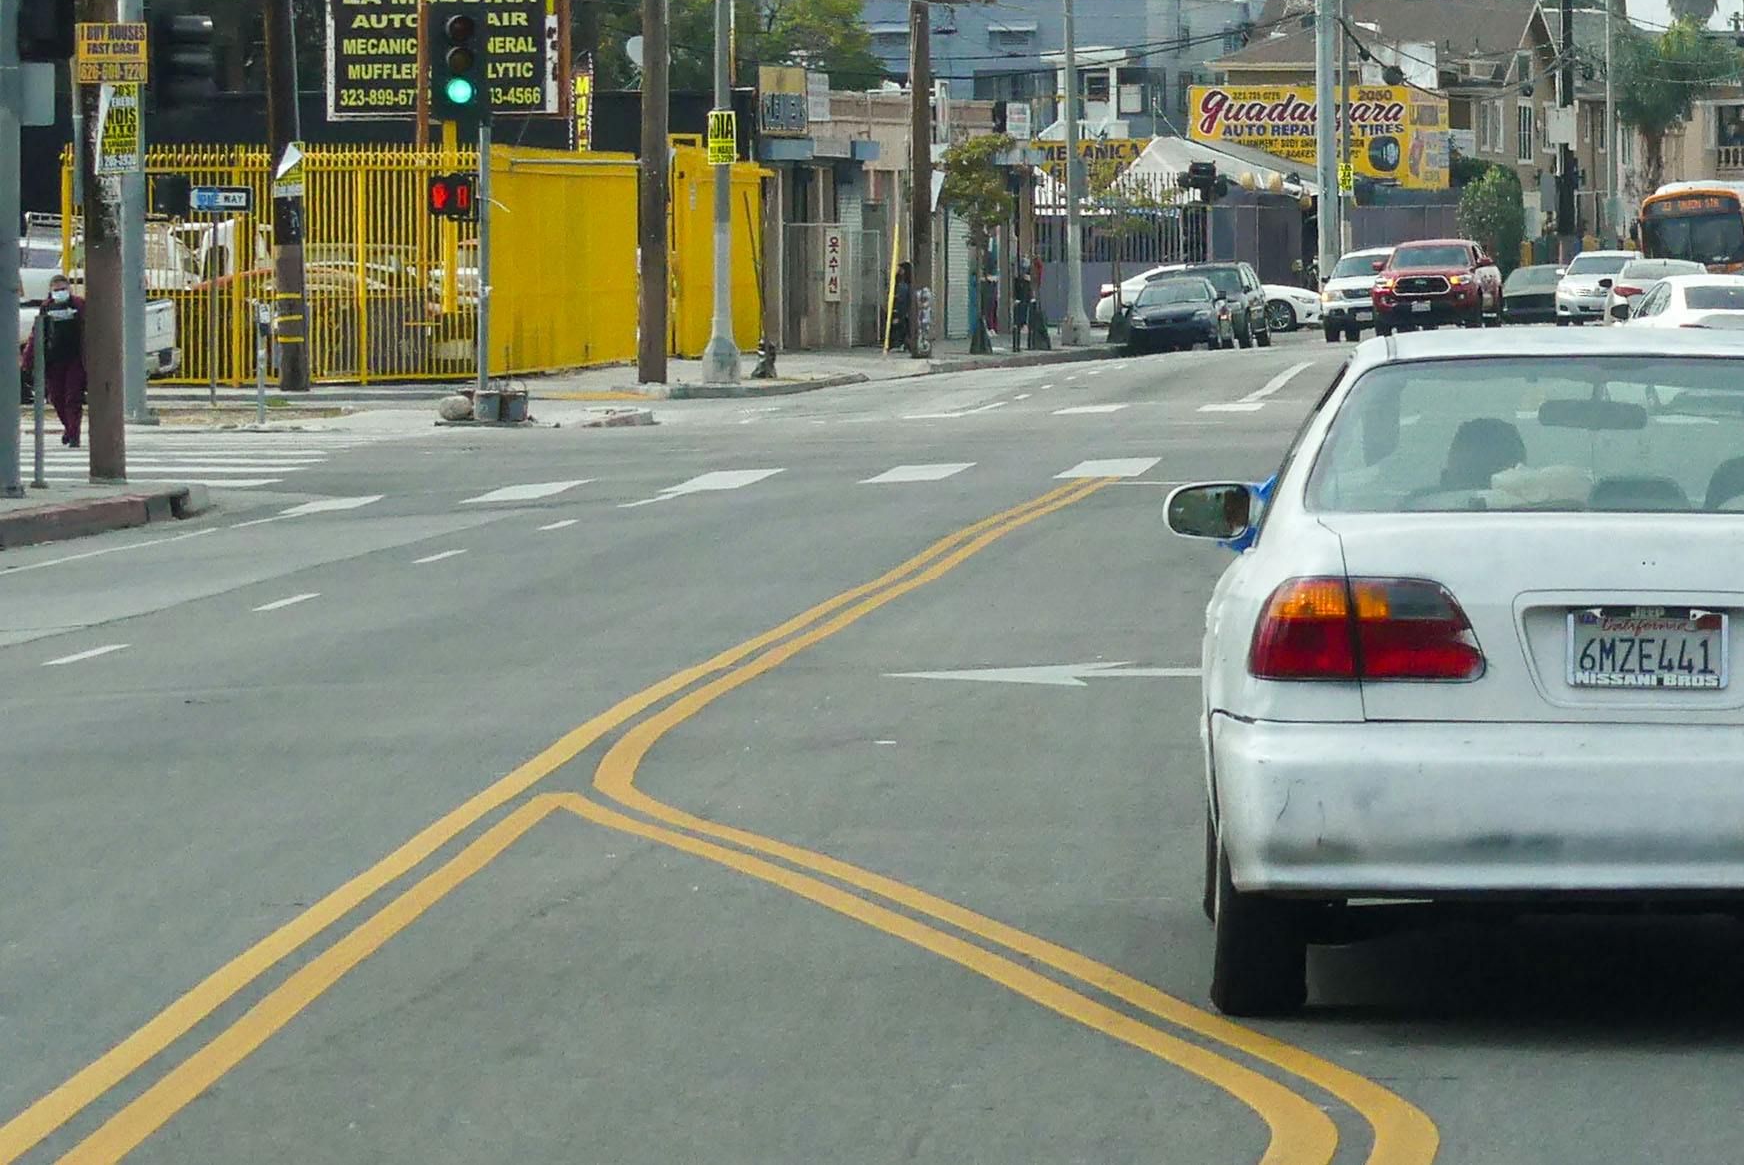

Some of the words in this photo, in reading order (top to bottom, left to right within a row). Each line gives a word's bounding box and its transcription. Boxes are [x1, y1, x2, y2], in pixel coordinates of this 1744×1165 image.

[87, 43, 110, 55] FAST
[112, 43, 140, 55] CASH
[1222, 123, 1267, 137] AUTO
[1271, 123, 1316, 137] REPAI
[1360, 122, 1405, 137] TIRES
[1036, 142, 1142, 162] MEANICA
[222, 194, 244, 205] WAY
[1579, 637, 1715, 674] 6MZE441
[1663, 673, 1720, 687] BROS
